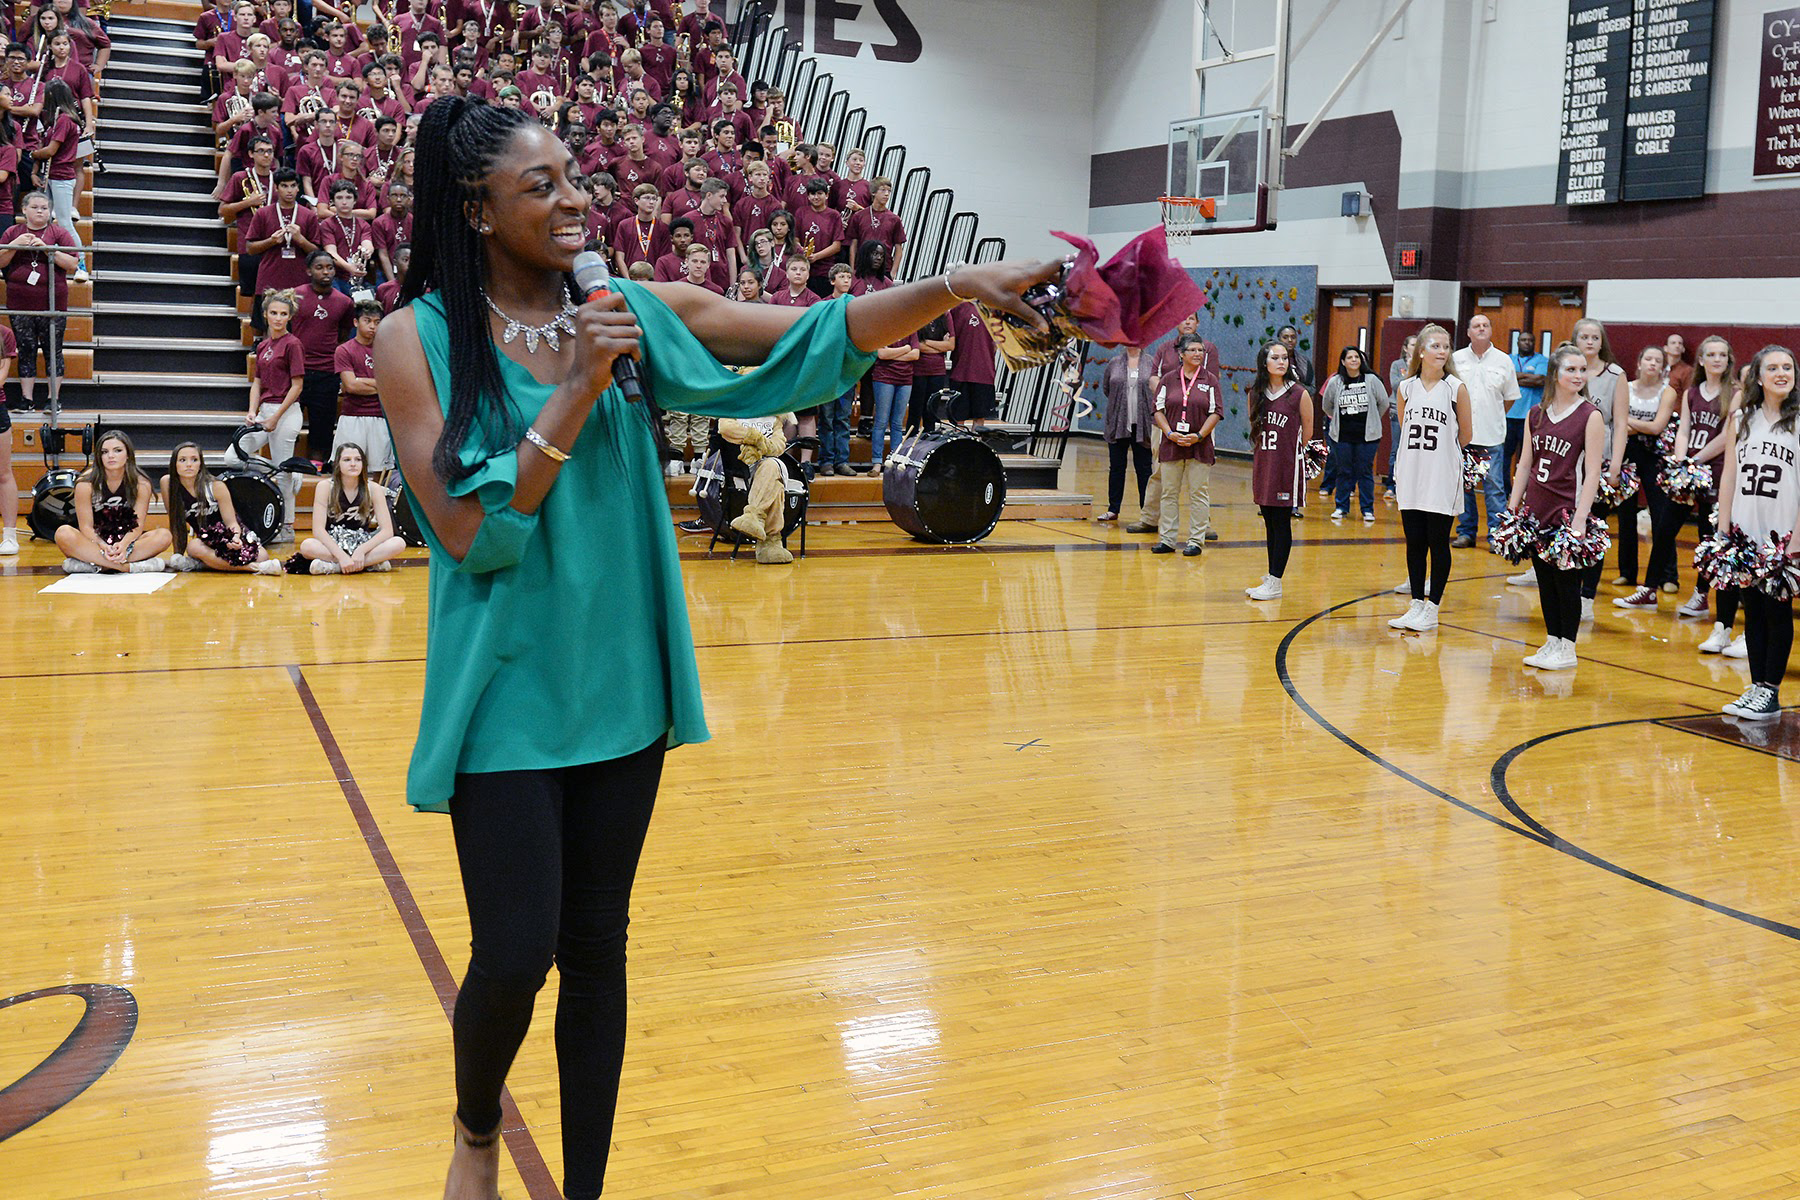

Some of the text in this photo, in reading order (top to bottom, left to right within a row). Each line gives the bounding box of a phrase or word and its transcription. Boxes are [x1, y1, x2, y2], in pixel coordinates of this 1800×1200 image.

[1597, 16, 1632, 34] ROGERS
[1634, 6, 1678, 26] 11 ADAM
[1632, 19, 1689, 40] 12 HUNTER
[1566, 35, 1609, 55] 2 VOGLER
[1632, 35, 1678, 55] 13 ISALY
[1566, 49, 1608, 69] 3 BOURNE
[1631, 48, 1690, 69] 14 BOWDRY
[1782, 57, 1799, 71] for
[1565, 65, 1596, 81] 4 SAMS
[1630, 61, 1708, 84] 15 RANDERMAN
[1770, 74, 1788, 89] We
[1564, 77, 1606, 95] 6 THOMAS
[1629, 78, 1692, 98] 16 SARBECK
[1563, 91, 1608, 109] 7 ELLIOTT
[1780, 89, 1797, 104] for
[1562, 106, 1598, 123] 8 BLACK
[1626, 109, 1676, 127] MANAGER
[1561, 118, 1609, 137] 9 JUNGMAN
[1636, 124, 1676, 140] OVIEDO
[1778, 124, 1795, 134] we
[1560, 134, 1599, 150] COACHES
[1635, 139, 1670, 155] COBLE
[1766, 135, 1788, 151] The
[1569, 146, 1606, 163] BENOTTI
[1569, 160, 1606, 177] PALMER
[1568, 175, 1604, 191] ELLIOTT
[1566, 188, 1606, 204] WHEELER
[1402, 249, 1416, 266] EXIT
[1261, 430, 1278, 450] 12
[1407, 424, 1439, 451] 25
[1688, 429, 1709, 450] 10
[1536, 457, 1552, 483] 5
[1741, 463, 1783, 499] 32
